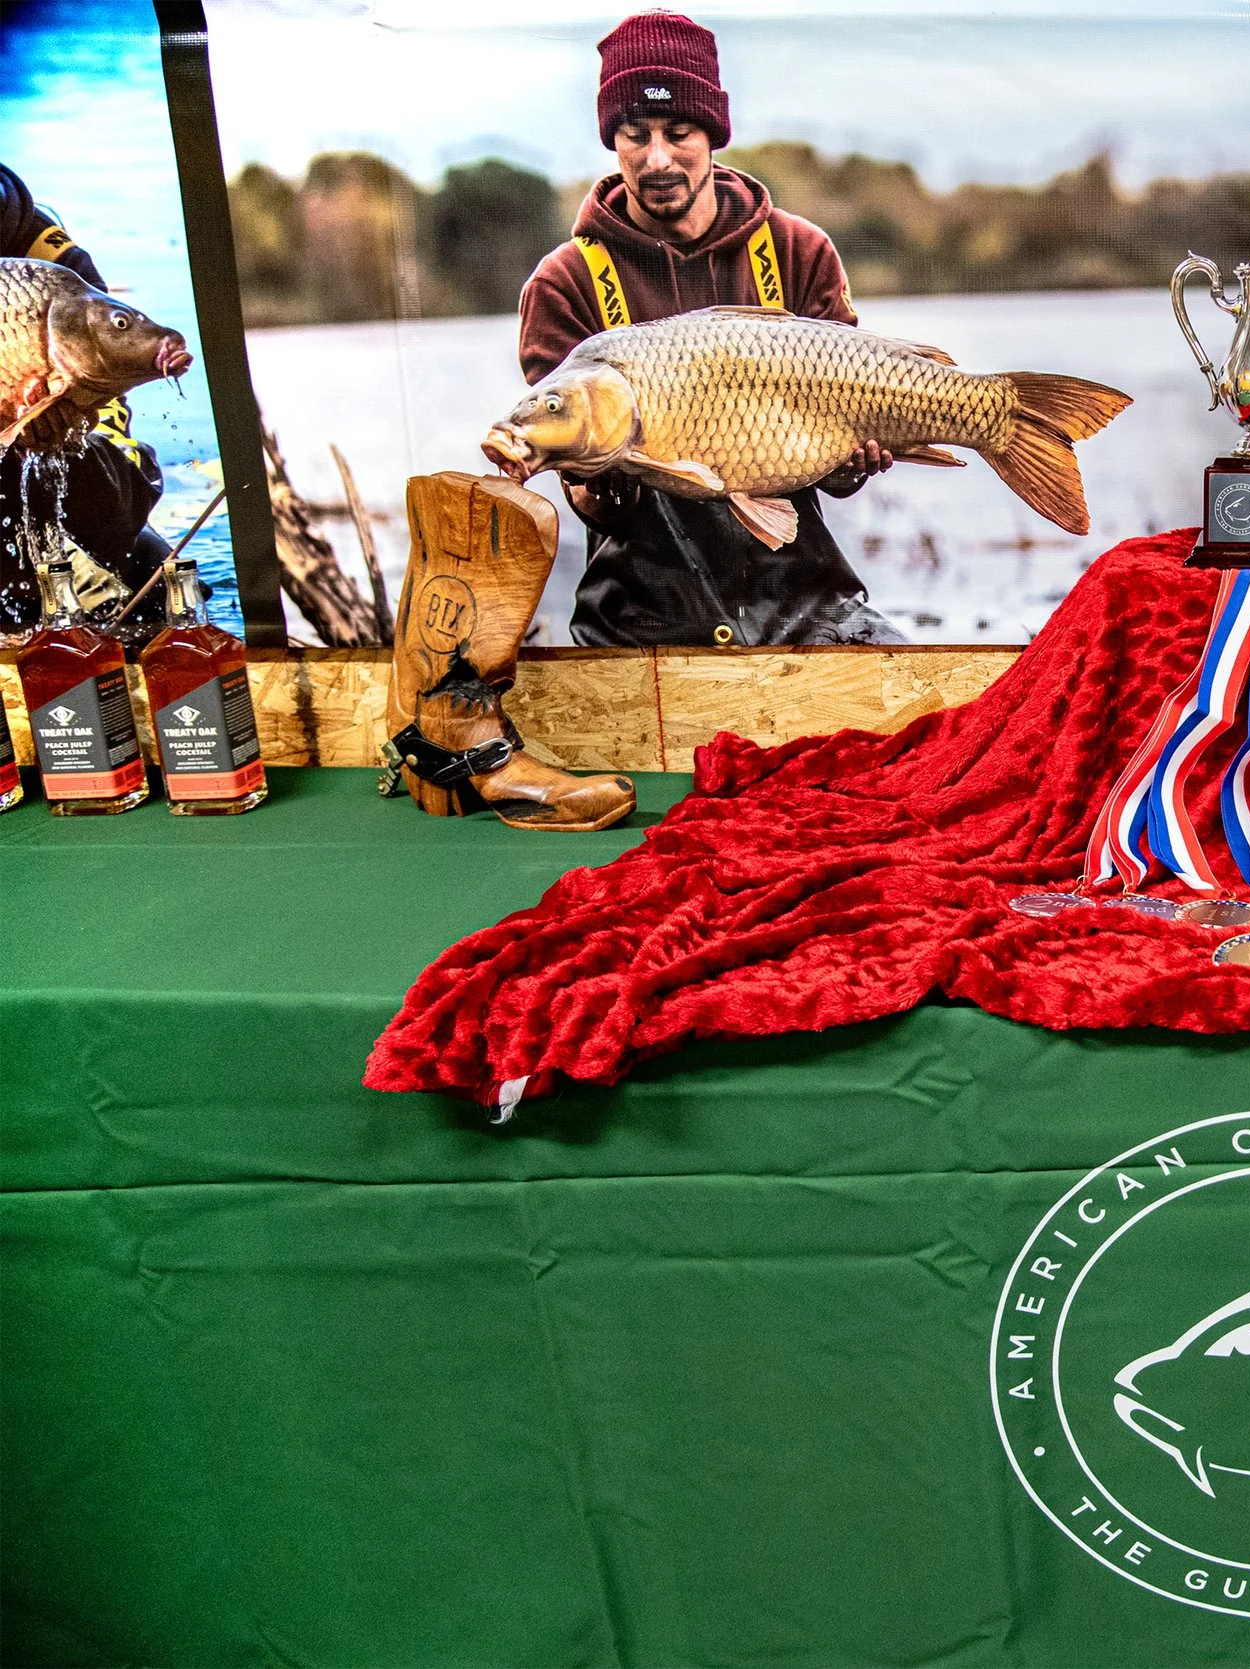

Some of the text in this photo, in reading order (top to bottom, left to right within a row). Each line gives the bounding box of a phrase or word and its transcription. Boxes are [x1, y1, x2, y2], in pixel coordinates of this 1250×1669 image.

[426, 593, 466, 632] BTX
[39, 727, 94, 737] TREATY OAK
[163, 727, 218, 737] TREATY OAK
[52, 748, 88, 756] COCKTAIL
[176, 748, 212, 756] COCKTAIL
[1007, 1147, 1187, 1400] AMERICAN
[1070, 1495, 1152, 1565] THE
